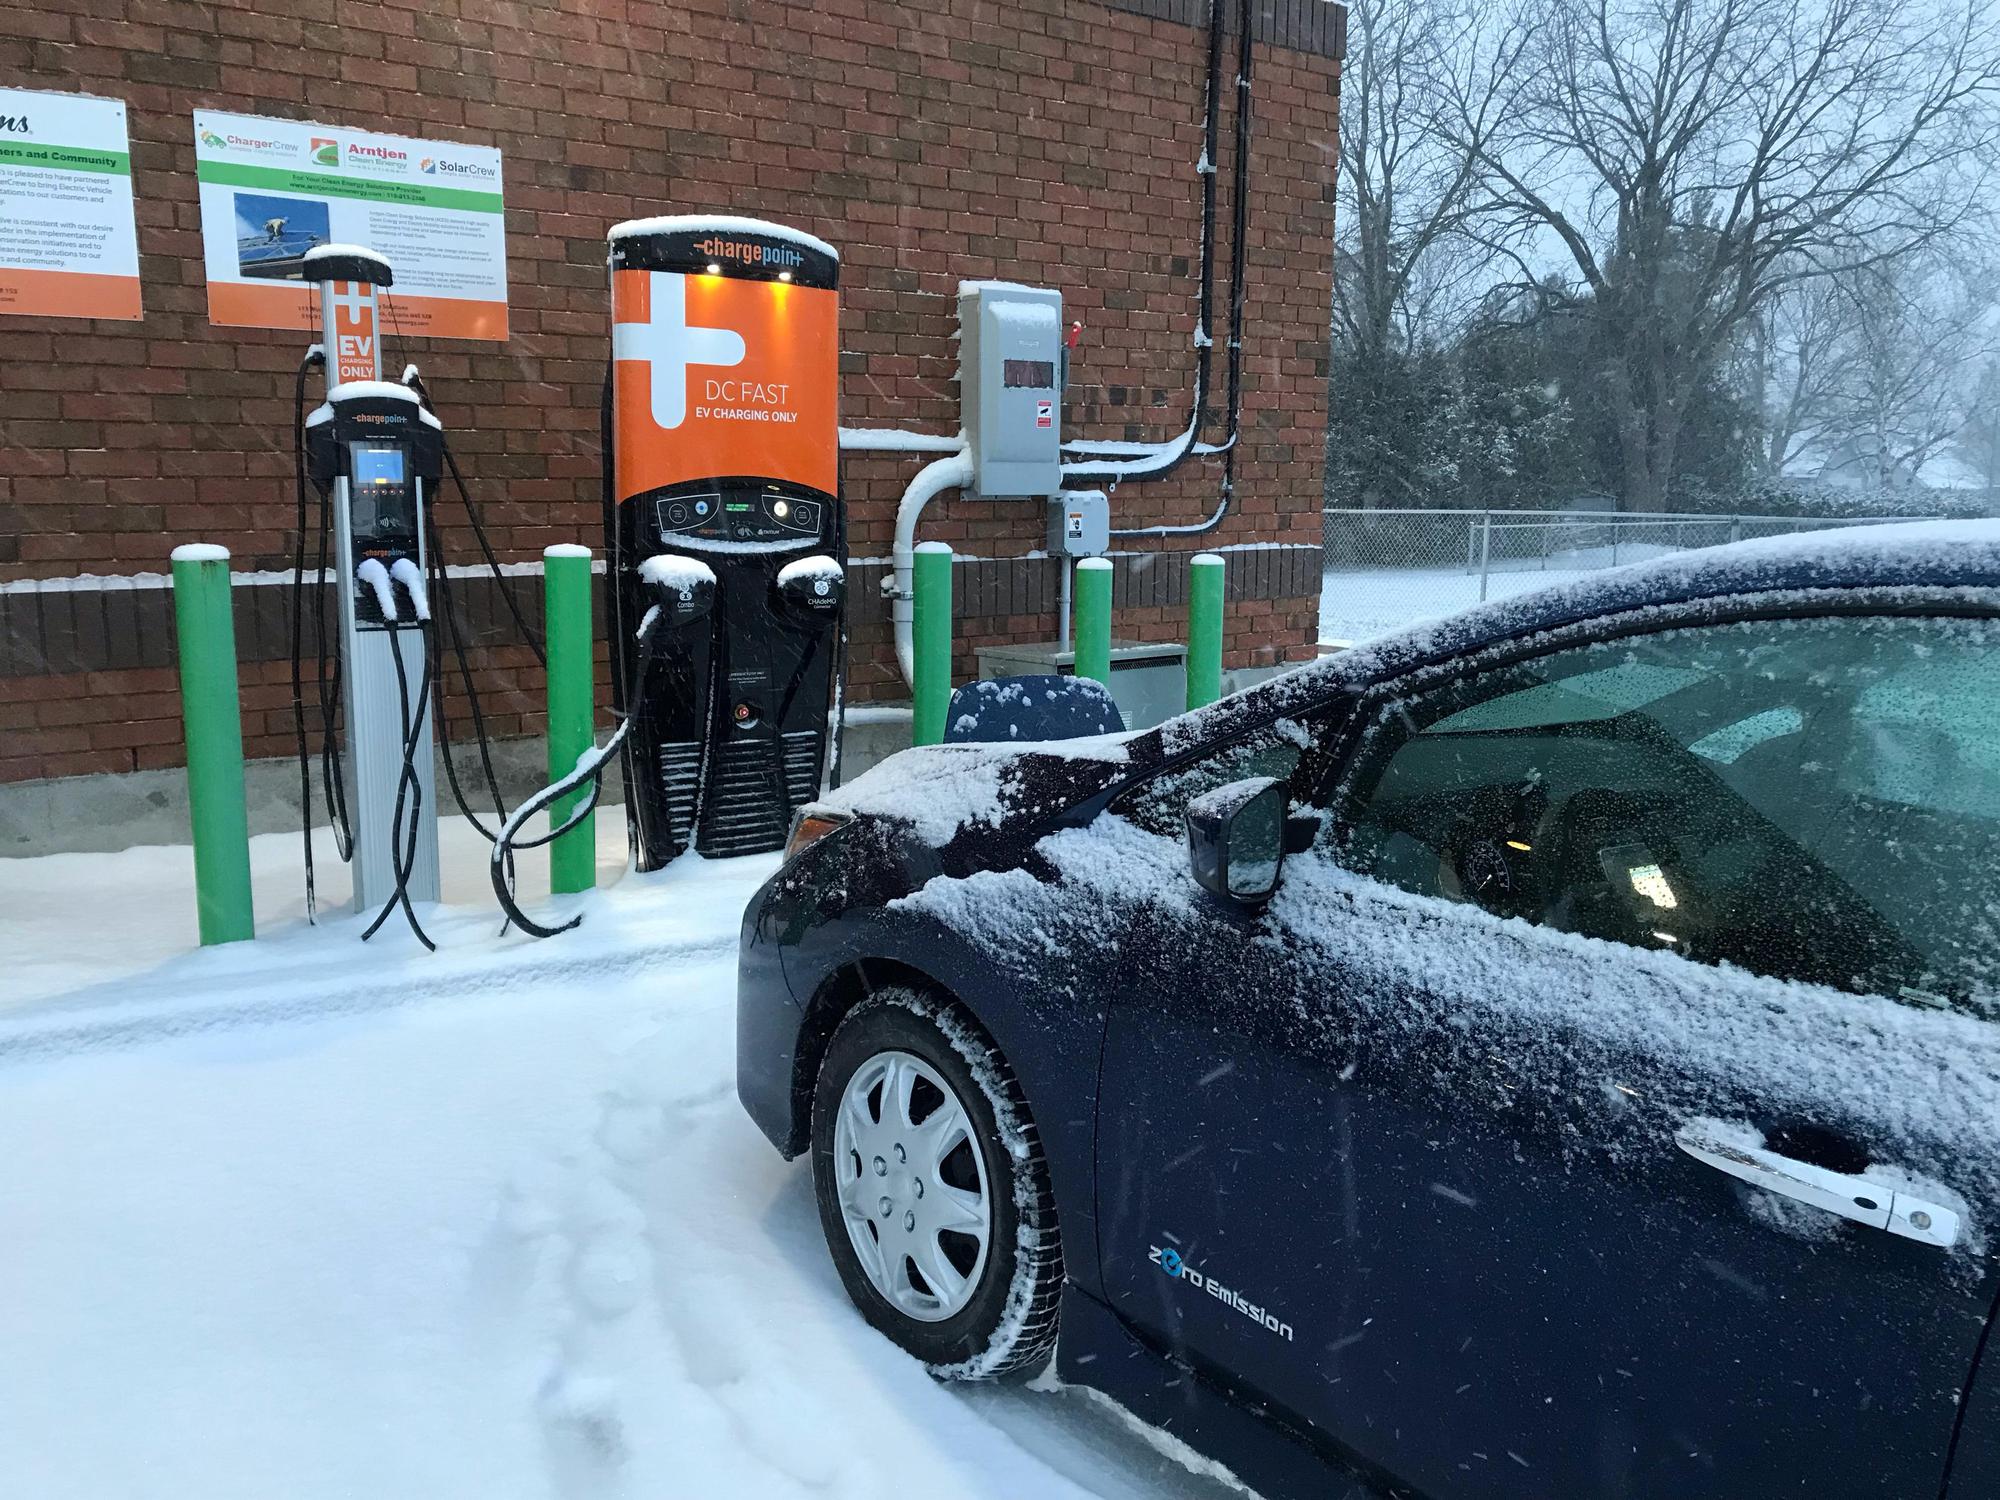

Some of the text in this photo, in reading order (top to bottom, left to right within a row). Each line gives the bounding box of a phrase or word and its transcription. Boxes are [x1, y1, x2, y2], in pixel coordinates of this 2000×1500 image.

[226, 134, 299, 152] ChargerCrew
[26, 151, 48, 159] and
[51, 152, 117, 168] Community
[348, 144, 407, 160] Arntjen
[348, 155, 407, 169] Clean Energy
[440, 160, 496, 177] SolarCrew
[14, 170, 44, 179] pleased
[55, 173, 72, 182] have
[73, 176, 110, 185] partnered
[37, 181, 57, 190] bring
[59, 183, 85, 192] Electric
[86, 185, 113, 194] Vehicle
[51, 193, 89, 202] customers
[90, 195, 104, 203] and
[20, 219, 58, 228] consistent
[60, 222, 76, 230] with
[91, 224, 114, 232] desire
[24, 228, 37, 236] the
[38, 229, 97, 240] implementation
[41, 238, 77, 248] initiatives
[78, 241, 92, 249] and
[17, 247, 43, 256] energy
[44, 248, 78, 258] solutions
[339, 335, 372, 356] EV
[341, 366, 374, 378] ONLY
[706, 380, 789, 405] DC FAST
[695, 406, 798, 422] EV CHARGING ONLY
[1206, 1277, 1293, 1342] Emission
